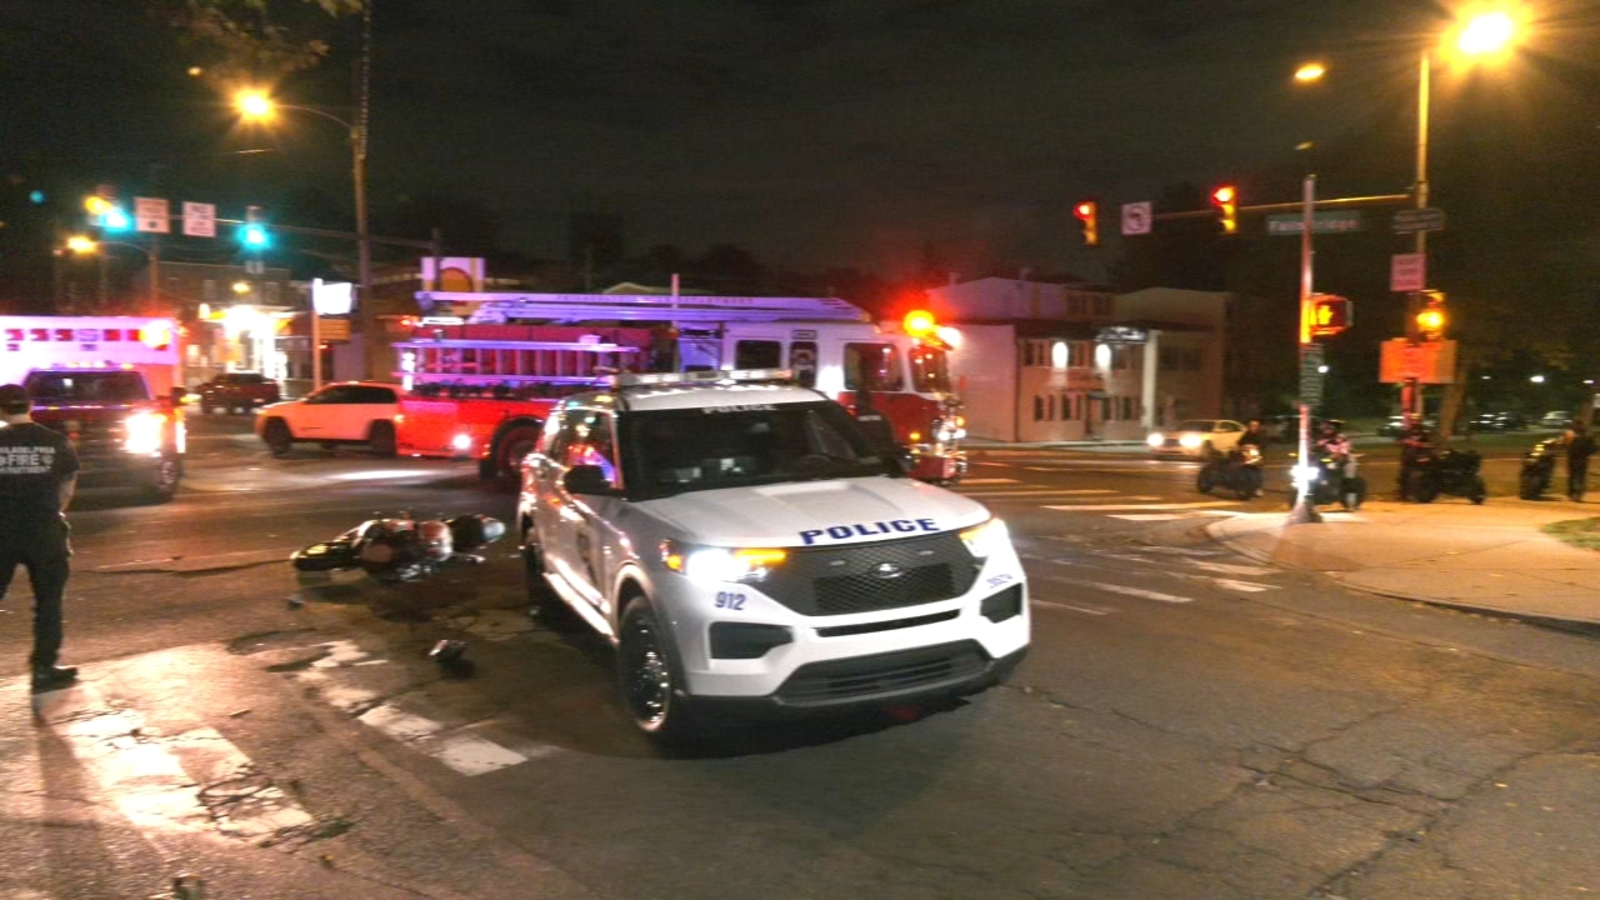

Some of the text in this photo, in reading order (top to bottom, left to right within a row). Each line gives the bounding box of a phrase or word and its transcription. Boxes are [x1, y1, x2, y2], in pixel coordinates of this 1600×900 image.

[701, 404, 778, 415] POLICE
[8, 454, 40, 466] FIRE
[798, 517, 941, 546] POLICE
[714, 590, 747, 611] 912
